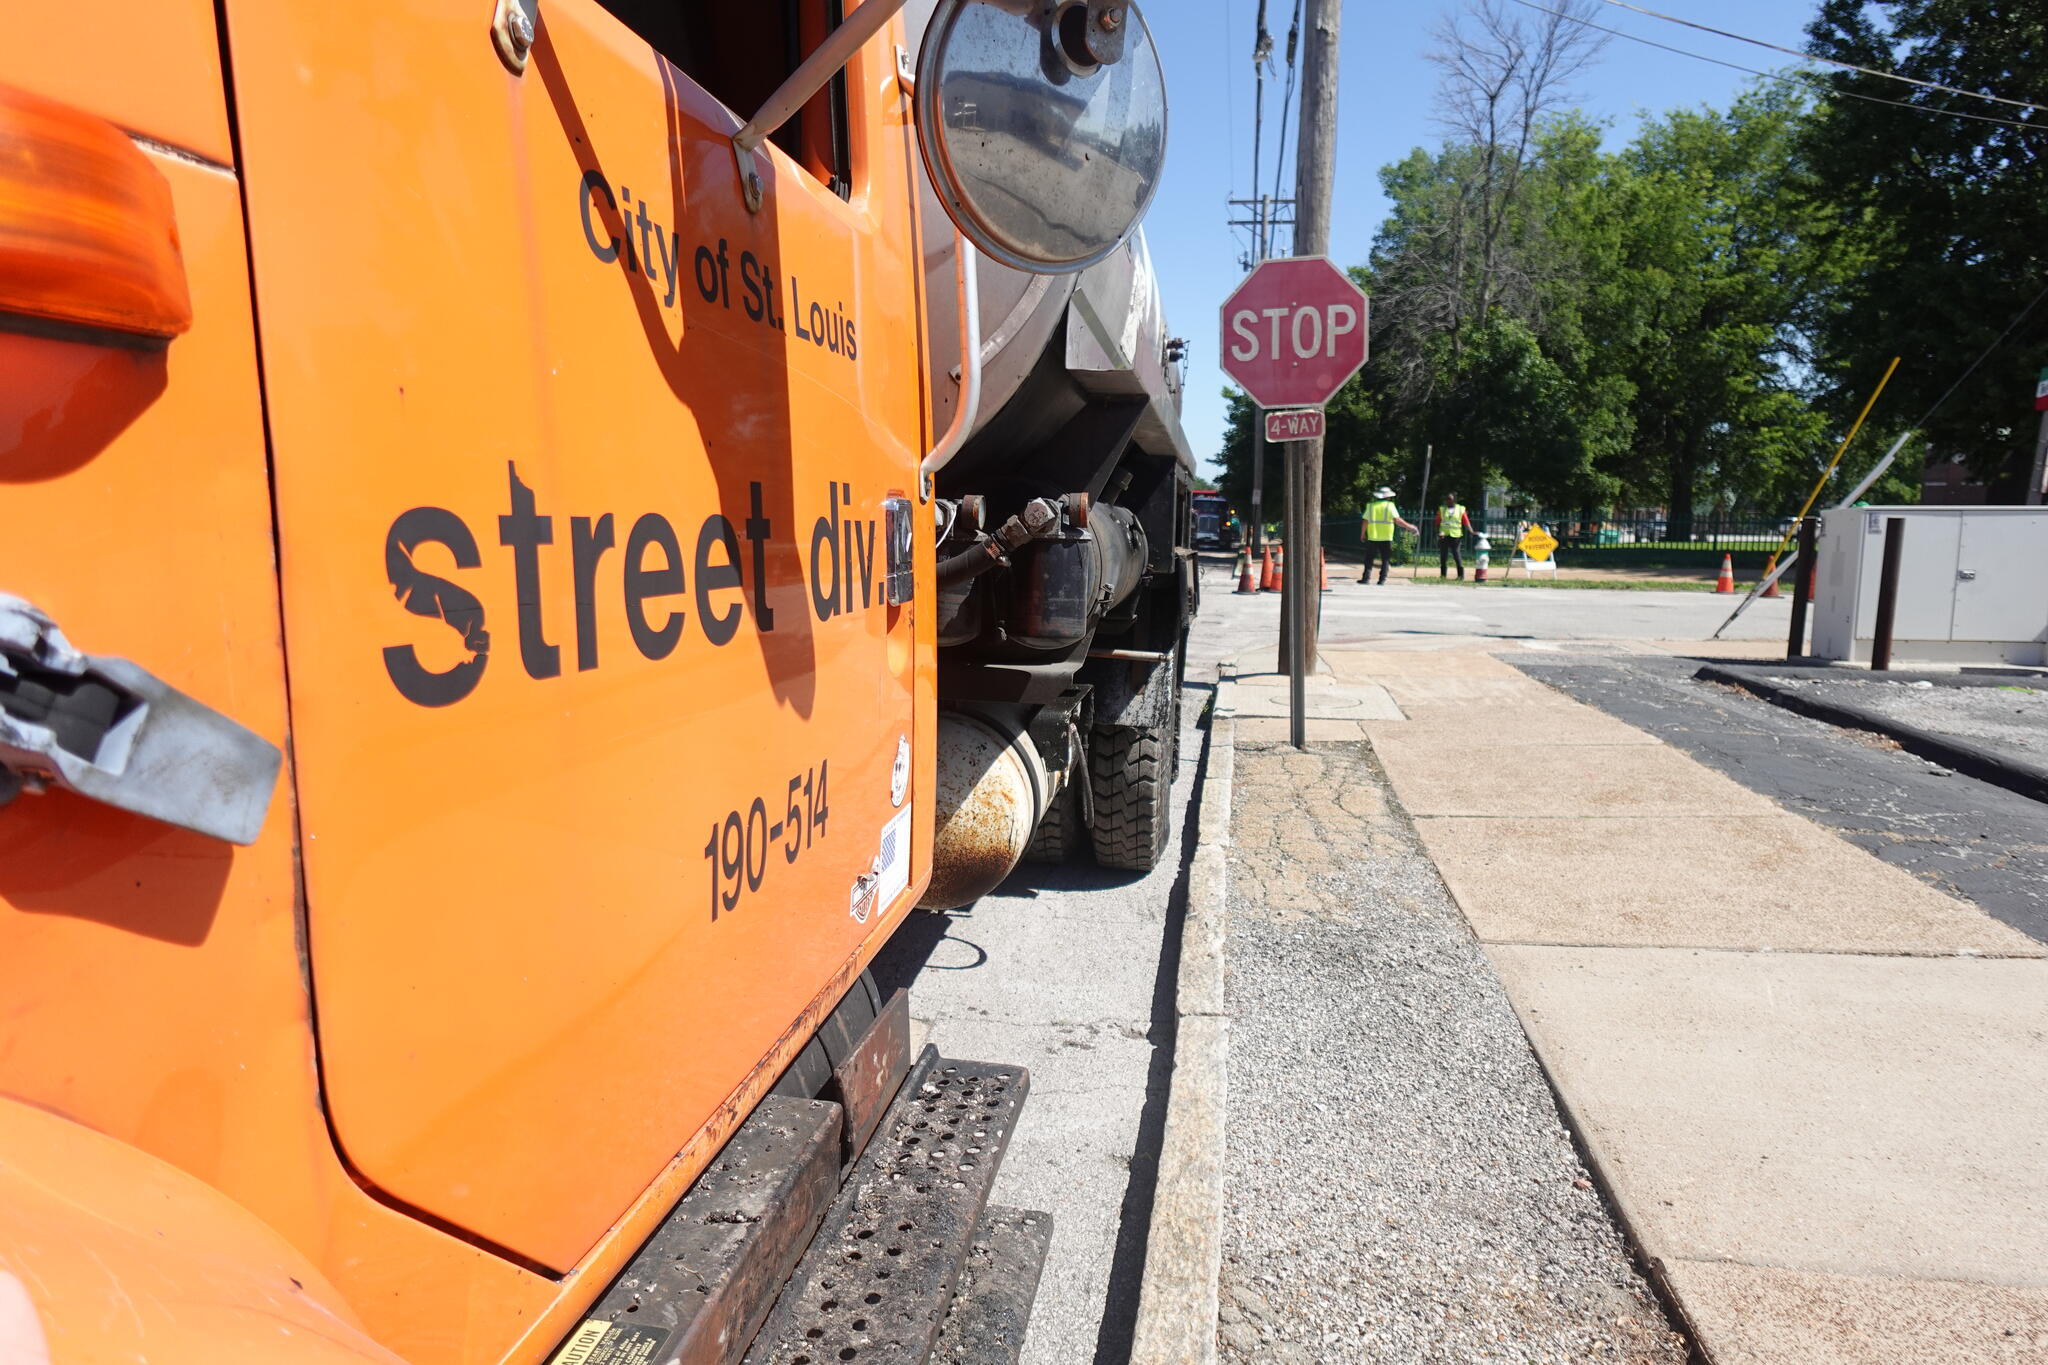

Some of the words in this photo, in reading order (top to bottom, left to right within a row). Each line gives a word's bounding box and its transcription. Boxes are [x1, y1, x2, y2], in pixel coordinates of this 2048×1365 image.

[580, 169, 679, 307] City
[695, 238, 730, 309] of
[742, 250, 785, 333] St.
[791, 276, 858, 361] Louis
[1231, 304, 1357, 361] STOP
[1270, 417, 1319, 435] 4-WAY
[382, 460, 775, 707] street
[811, 481, 885, 622] div.
[704, 758, 829, 923] 190-514
